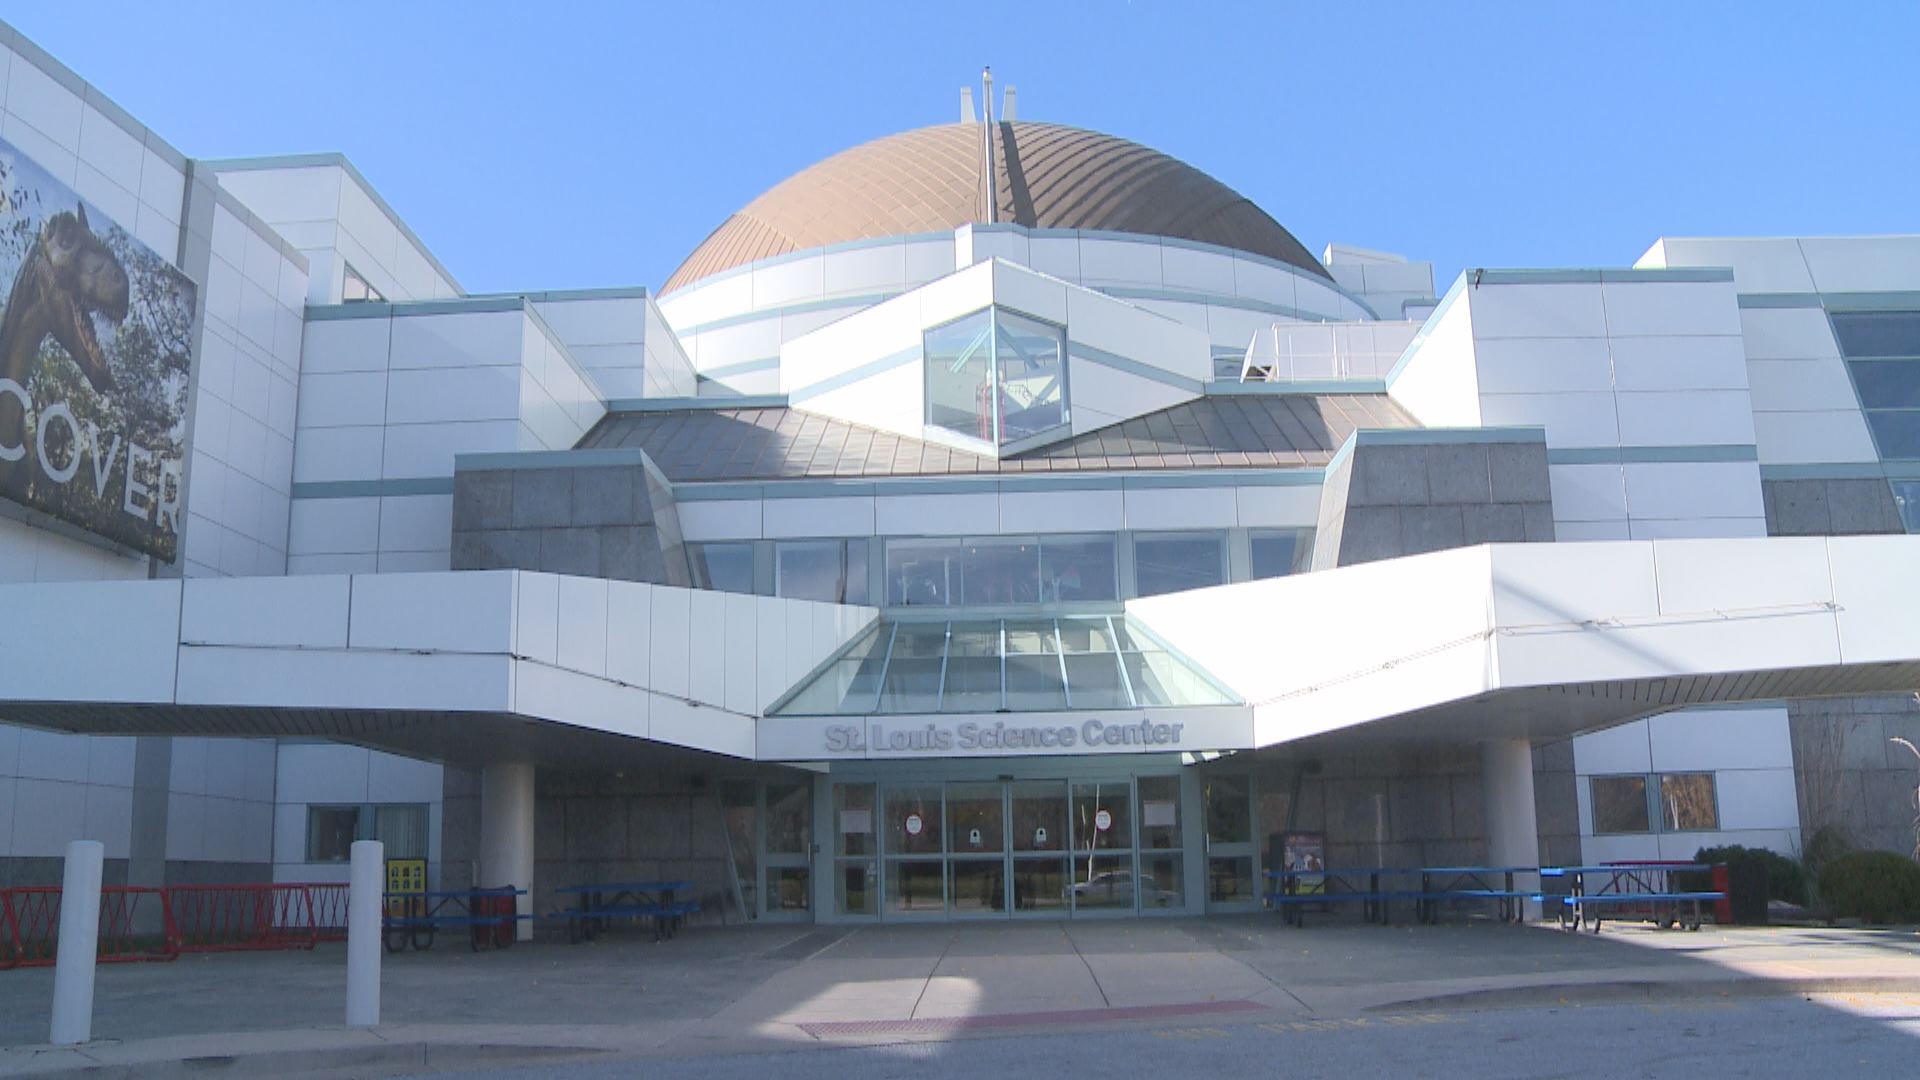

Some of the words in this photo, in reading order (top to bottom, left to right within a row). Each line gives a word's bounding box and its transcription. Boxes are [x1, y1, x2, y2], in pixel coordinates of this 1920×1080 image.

[825, 724, 866, 751] St.
[872, 723, 951, 751] Louis
[957, 722, 1077, 749] Science
[1081, 719, 1184, 747] Center
